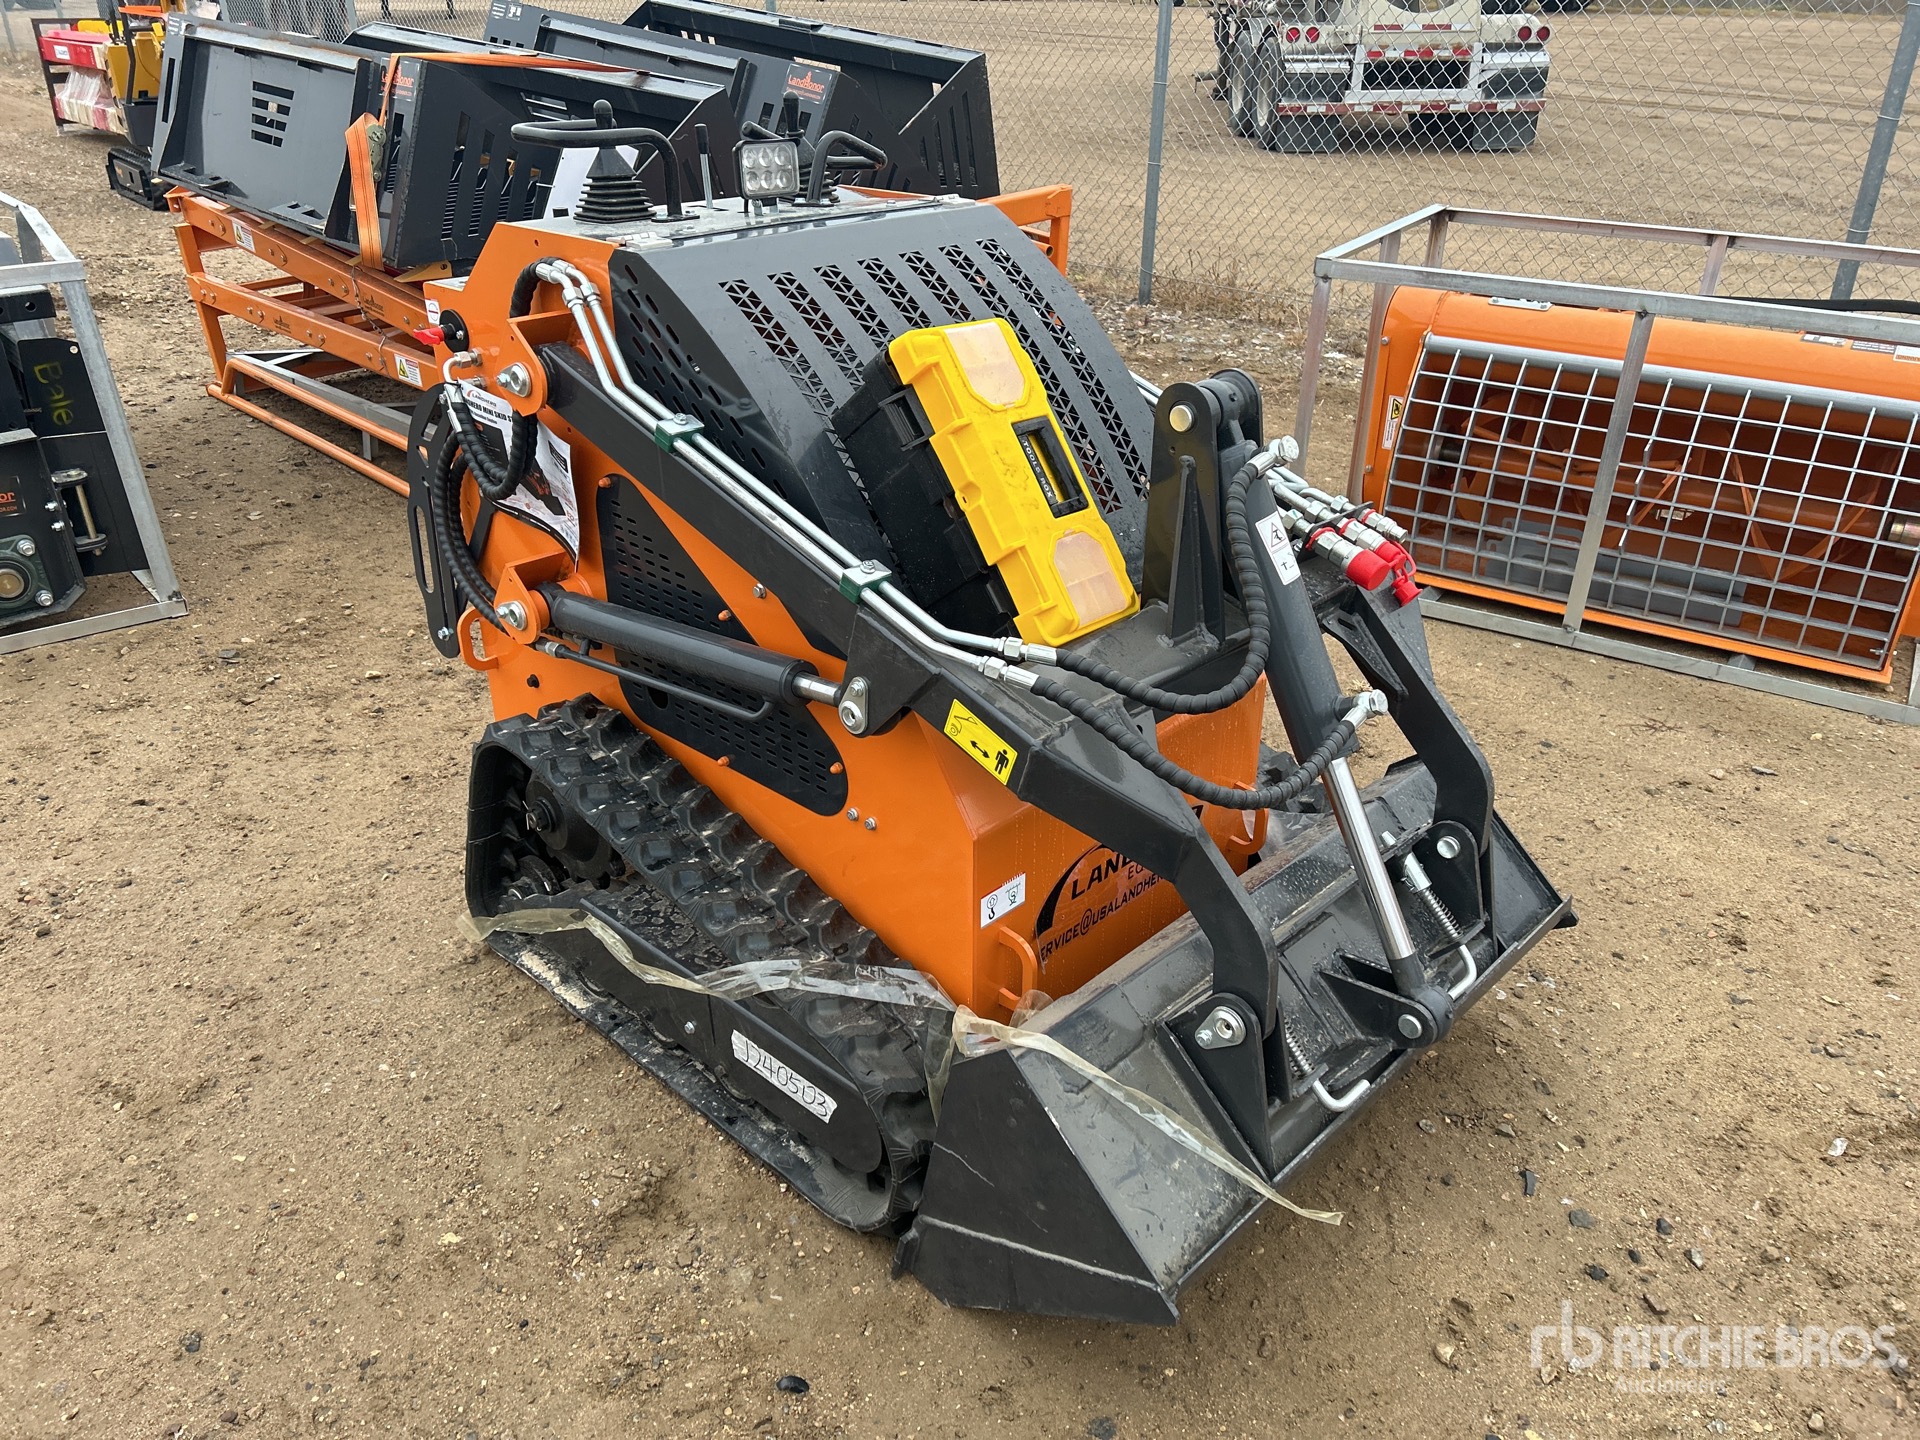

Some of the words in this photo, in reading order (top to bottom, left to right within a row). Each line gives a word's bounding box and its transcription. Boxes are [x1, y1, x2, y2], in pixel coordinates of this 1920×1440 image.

[788, 72, 824, 92] LandHonor
[494, 410, 507, 420] SKID
[1023, 440, 1041, 473] TOOLS
[1040, 477, 1053, 497] BOX
